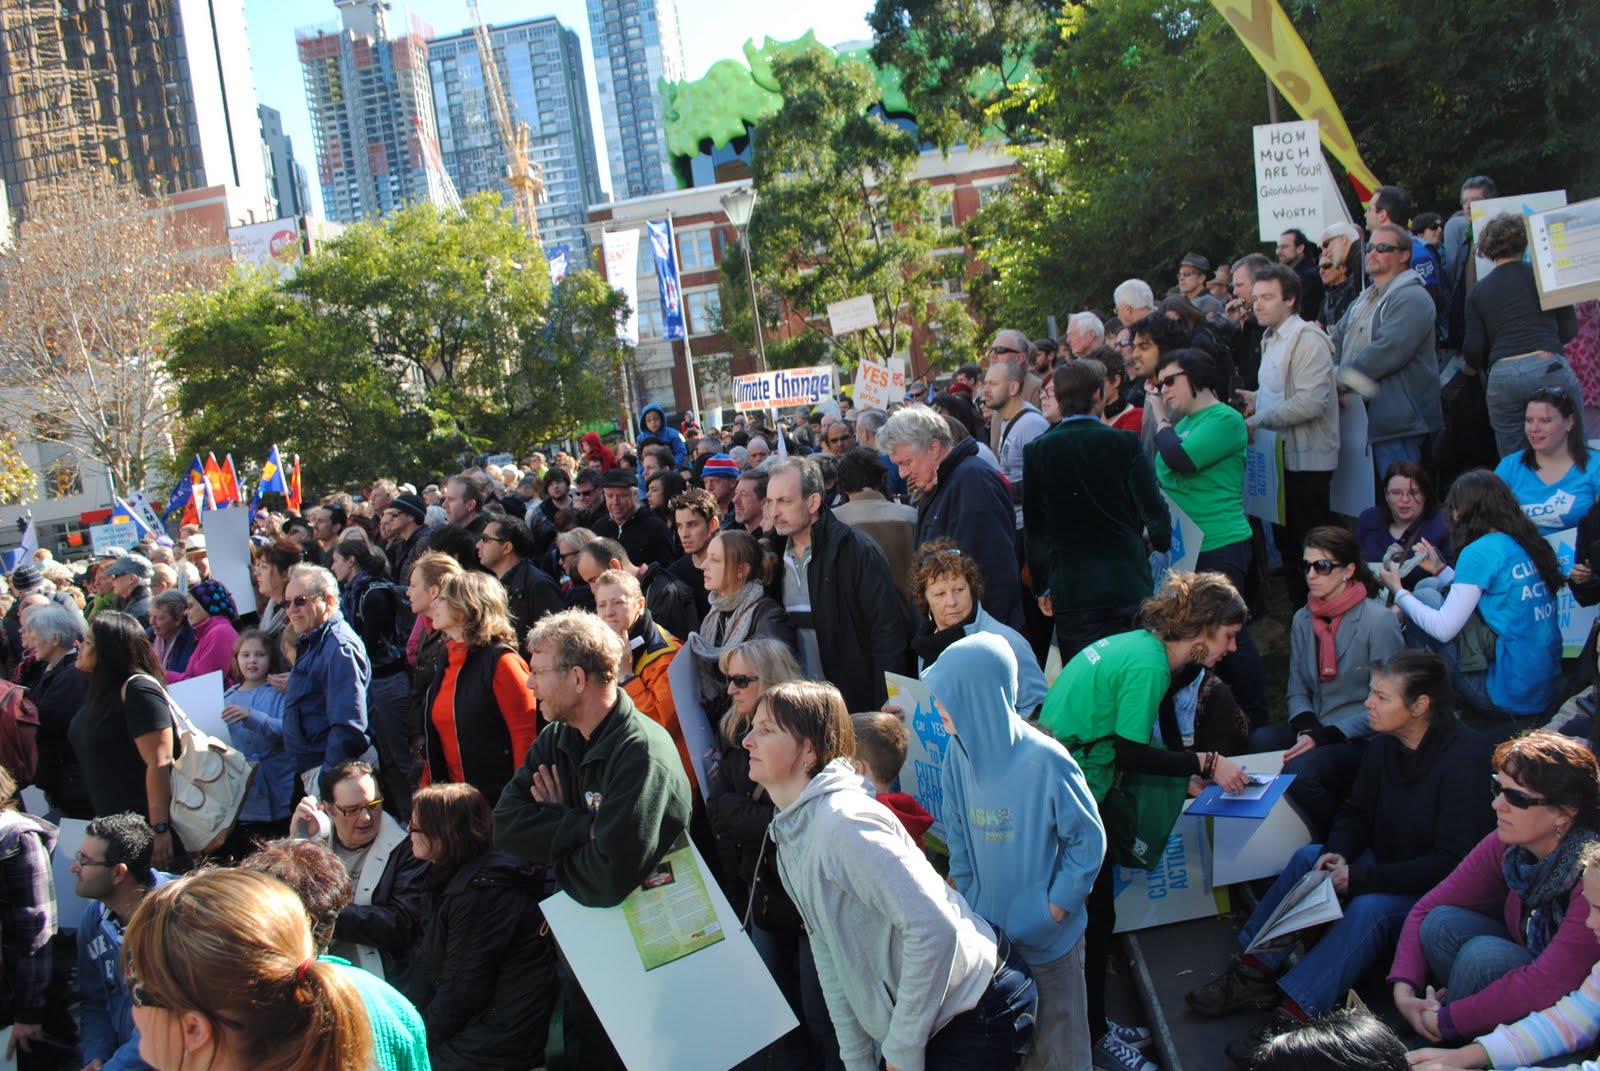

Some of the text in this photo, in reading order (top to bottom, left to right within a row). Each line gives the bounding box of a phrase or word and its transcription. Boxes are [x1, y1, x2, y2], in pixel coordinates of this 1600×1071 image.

[1270, 130, 1306, 146] HOW
[1260, 146, 1310, 163] MUCH
[1264, 162, 1322, 180] ARE YOUR
[1272, 207, 1317, 220] WORTH
[863, 363, 890, 388] YES
[734, 372, 830, 404] Climate Change
[865, 383, 872, 392] to
[859, 391, 881, 405] price
[1256, 452, 1267, 496] ACTION
[915, 719, 946, 738] SAY YES
[929, 750, 939, 764] TO
[914, 759, 943, 786] CUTT
[1166, 832, 1188, 889] ACTION
